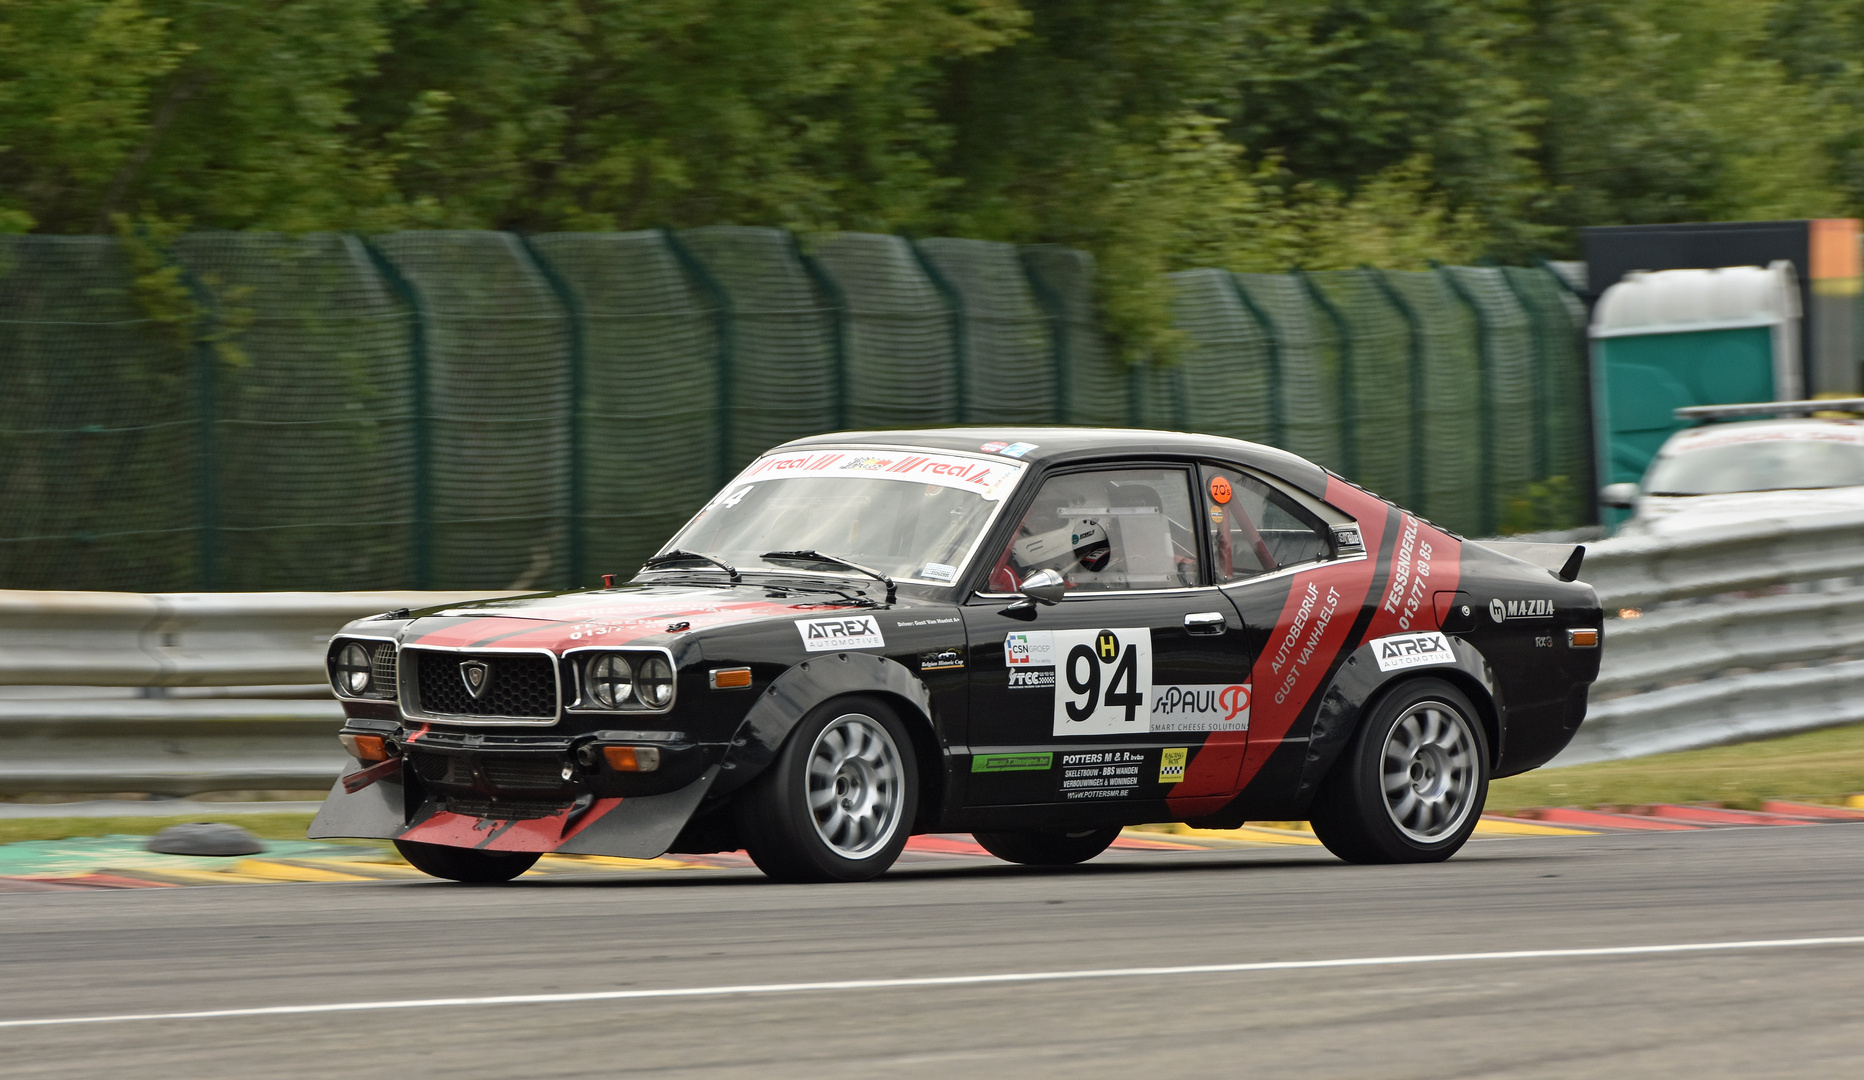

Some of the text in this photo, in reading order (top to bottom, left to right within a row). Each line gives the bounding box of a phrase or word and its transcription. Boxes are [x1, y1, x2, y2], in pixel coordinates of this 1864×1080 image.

[767, 454, 975, 478] real real
[1212, 484, 1231, 496] 70's
[1399, 540, 1433, 630] 013/77 69 85
[1507, 599, 1555, 616] MAZDA
[808, 619, 876, 639] ATREX
[1271, 582, 1319, 675] AUTOBEDRIJF
[810, 637, 879, 648] AUTOMOTIVE
[1100, 635, 1115, 657] H
[1274, 586, 1341, 705] GUST VANHAELST
[1382, 636, 1446, 659] ATREX
[1384, 653, 1452, 668] AUTOMOTIVE
[1065, 643, 1143, 722] 94
[1151, 723, 1175, 731] SMART
[1178, 723, 1205, 731] CHEESE
[1062, 753, 1103, 765] POTTERS
[1104, 752, 1113, 762] M
[1114, 752, 1121, 761] &
[1123, 751, 1130, 761] R
[1065, 769, 1099, 778] SKELETBOUW
[1102, 767, 1116, 776] BBS
[1116, 767, 1139, 775] WANDEN
[1063, 777, 1138, 788] VERBOUWINGEN & WONINGEN
